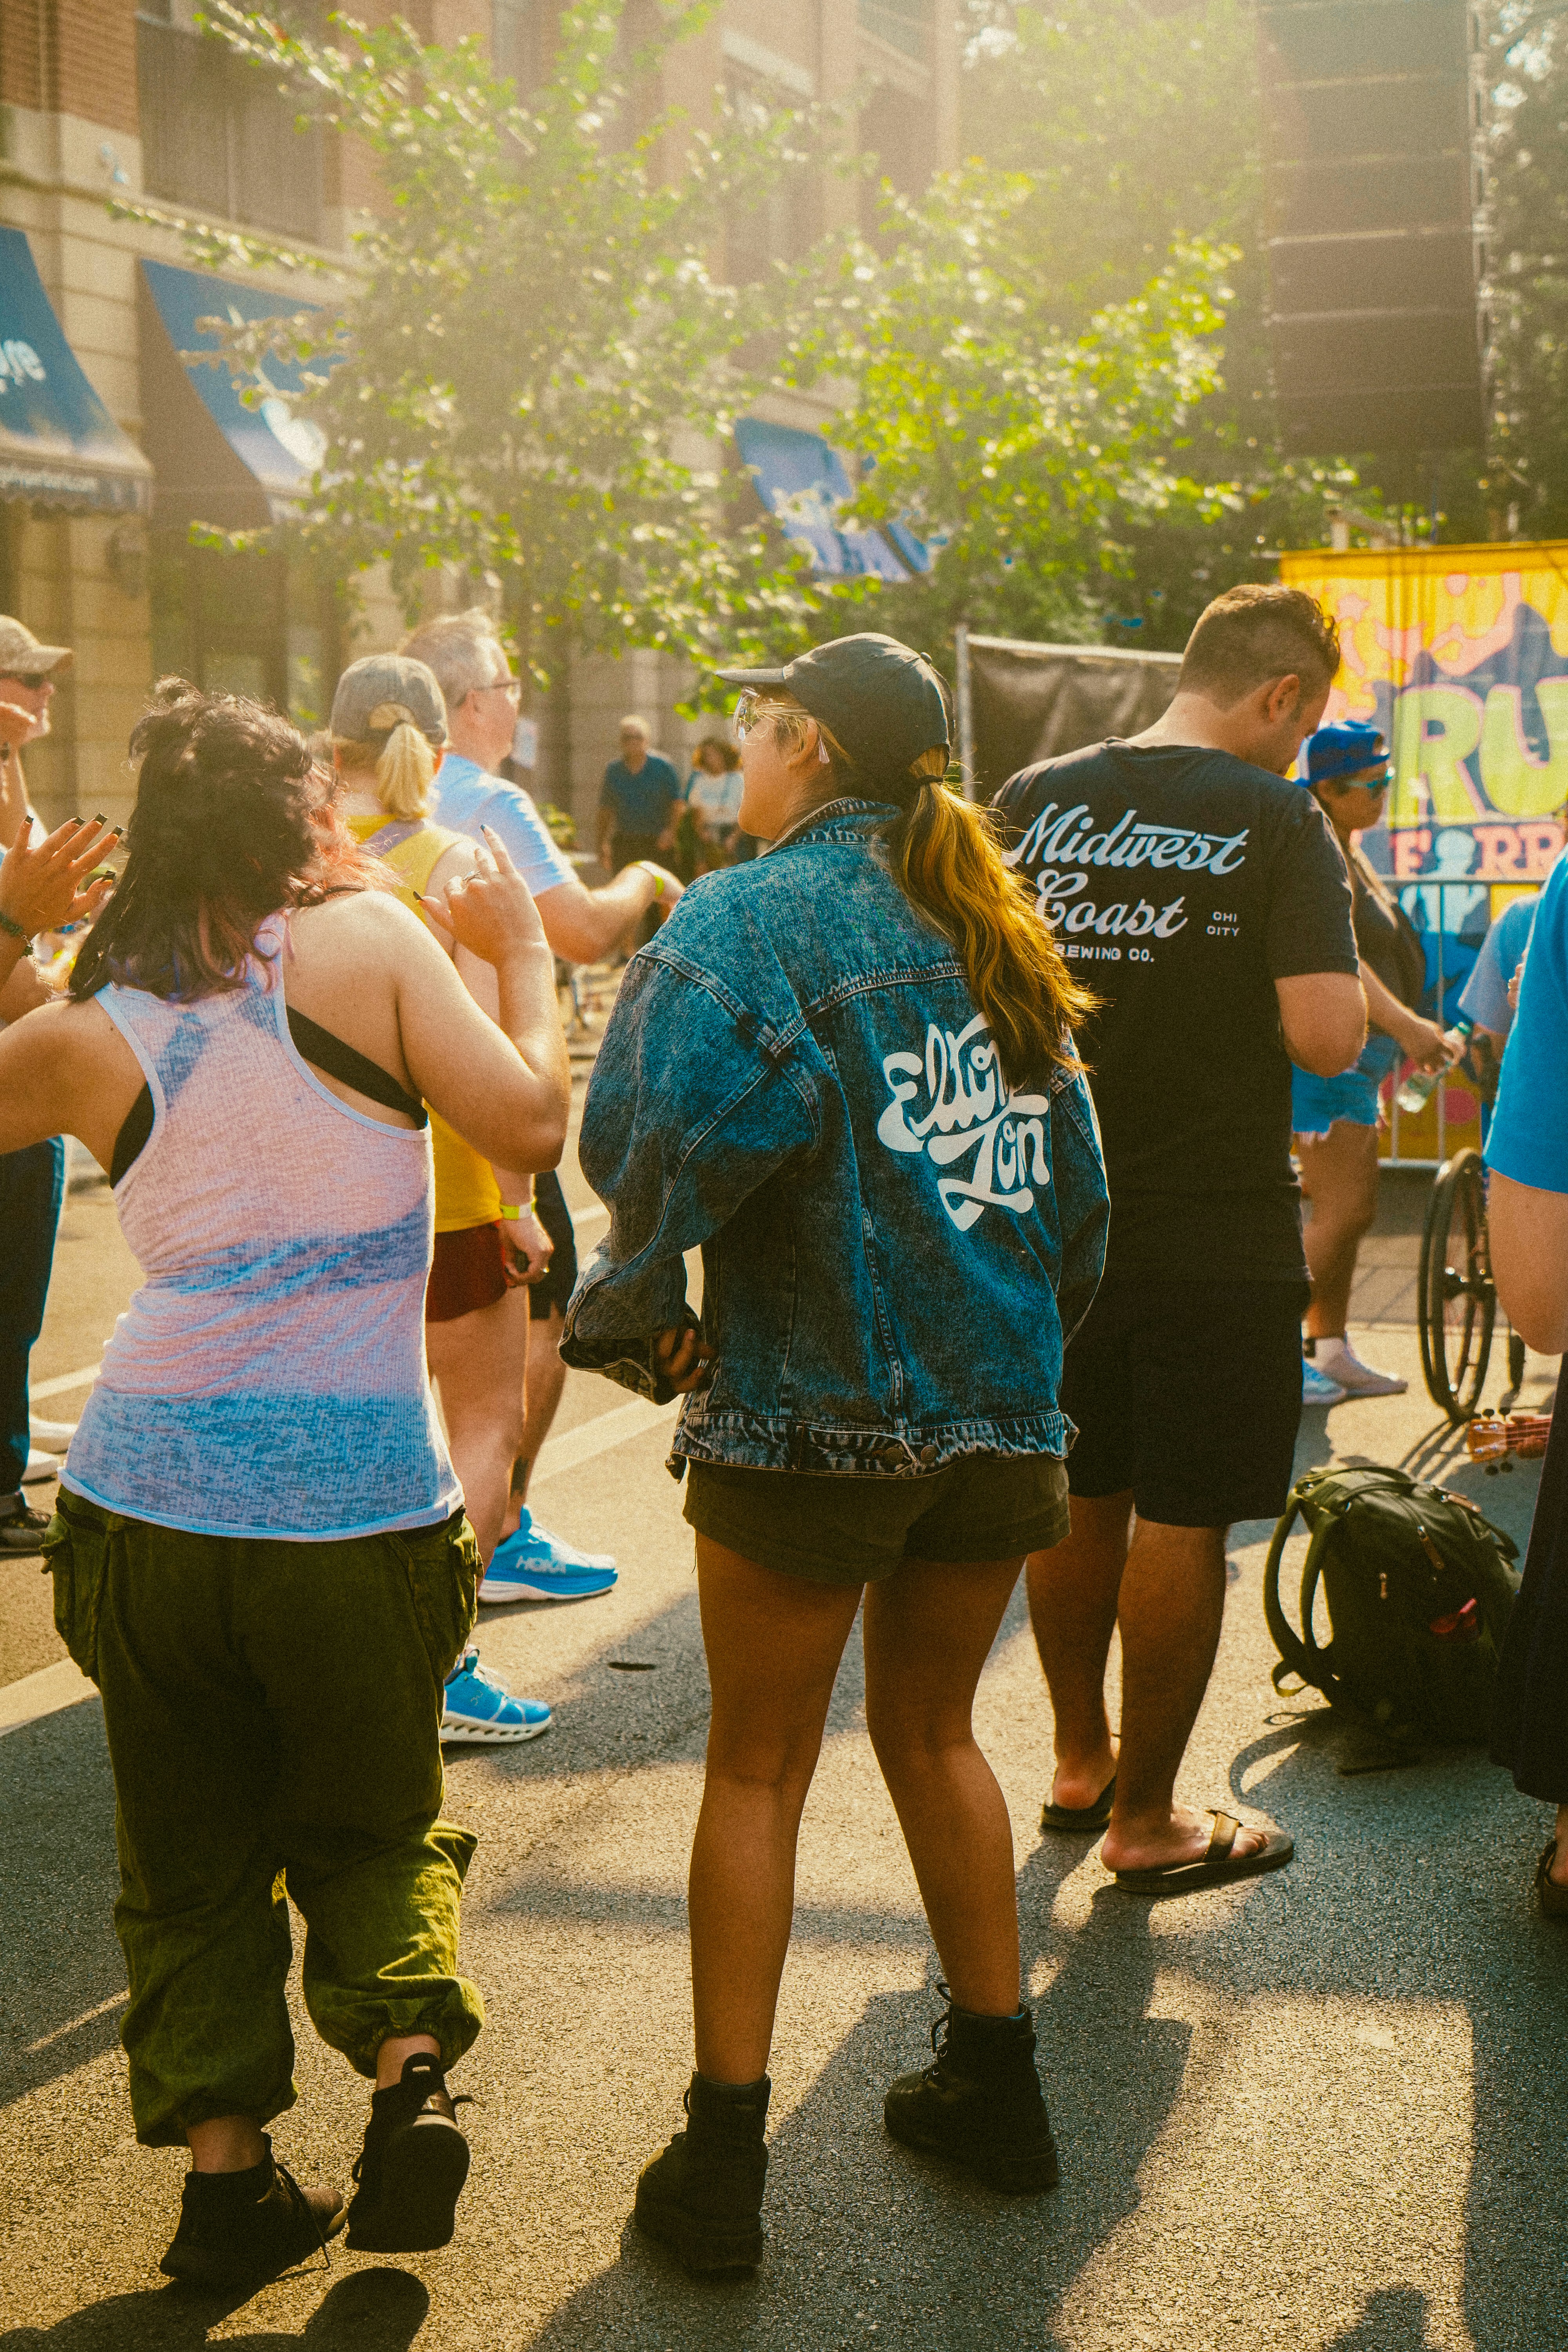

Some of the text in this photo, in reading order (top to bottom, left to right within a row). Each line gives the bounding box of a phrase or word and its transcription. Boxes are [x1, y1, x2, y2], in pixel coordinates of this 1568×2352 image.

[1002, 802, 1249, 875] Midwest
[1035, 869, 1188, 938] Coast
[1053, 943, 1155, 963] REWING CO.
